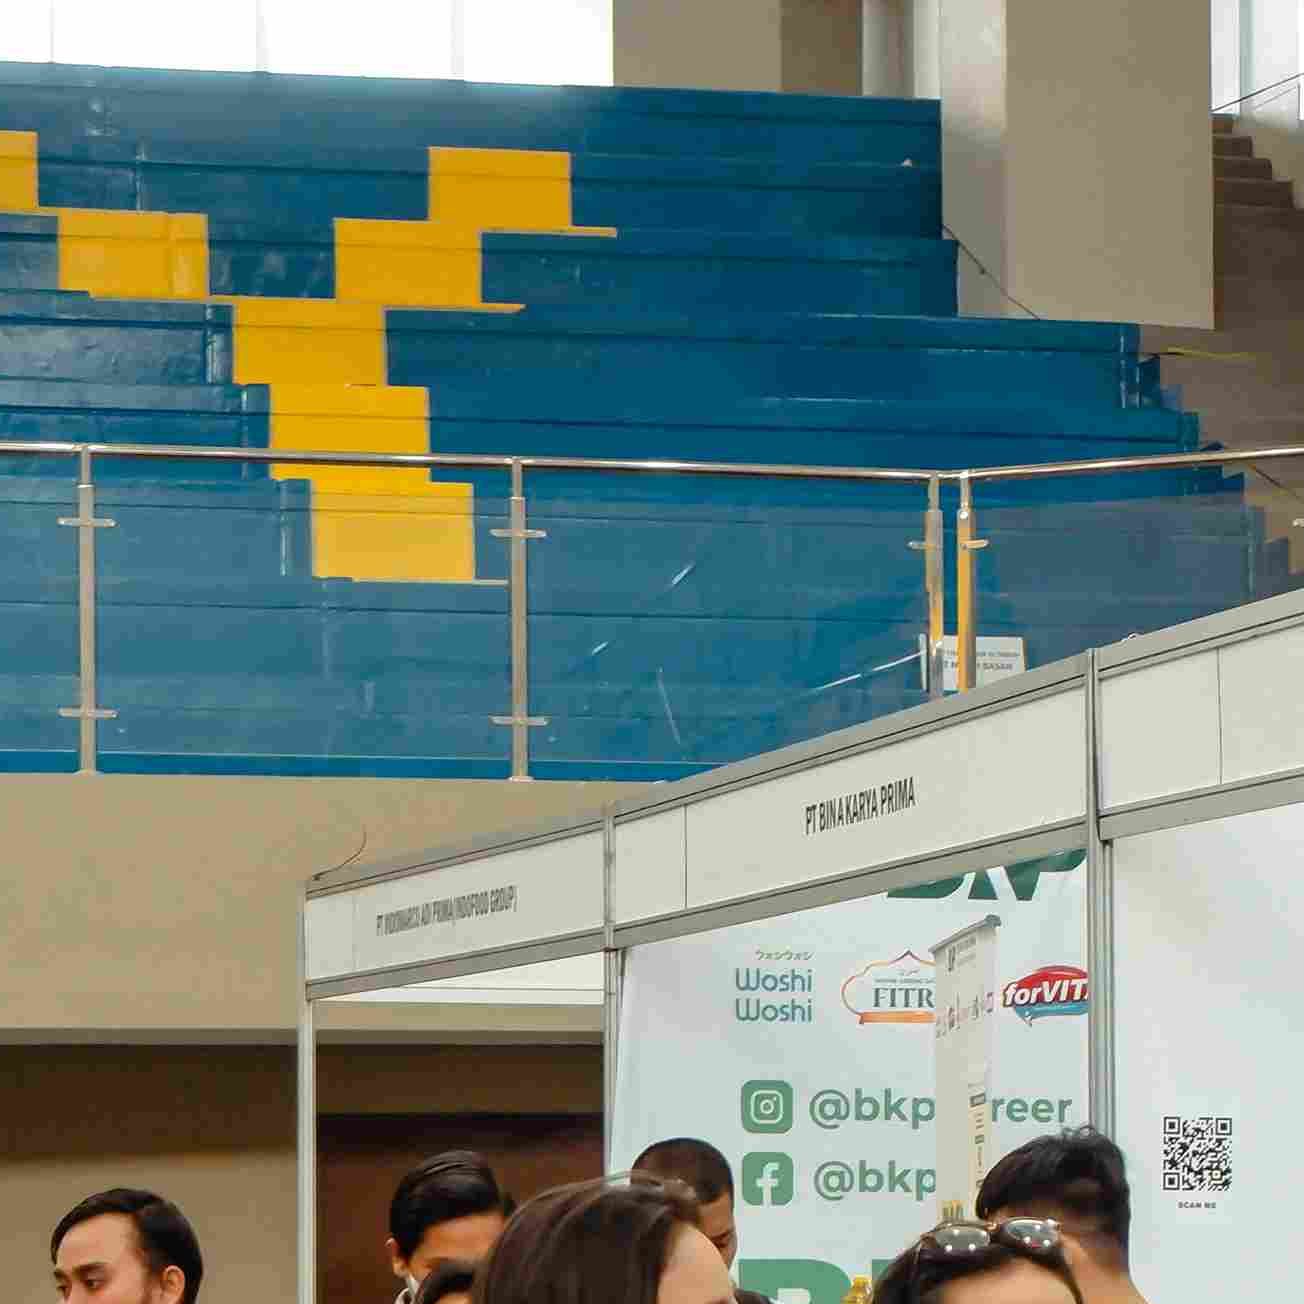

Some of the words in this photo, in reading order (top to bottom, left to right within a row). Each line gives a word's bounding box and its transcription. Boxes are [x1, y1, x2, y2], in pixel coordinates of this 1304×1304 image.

[806, 804, 817, 836] PT
[819, 798, 845, 832] BINA
[845, 788, 877, 824] KARYA
[880, 777, 916, 816] PRIMA
[376, 914, 384, 936] PT
[735, 968, 813, 993] Woshi
[1003, 978, 1088, 1008] forVIT
[873, 987, 936, 1008] FITR
[735, 998, 813, 1023] Woshi
[813, 1160, 936, 1201] @bkp
